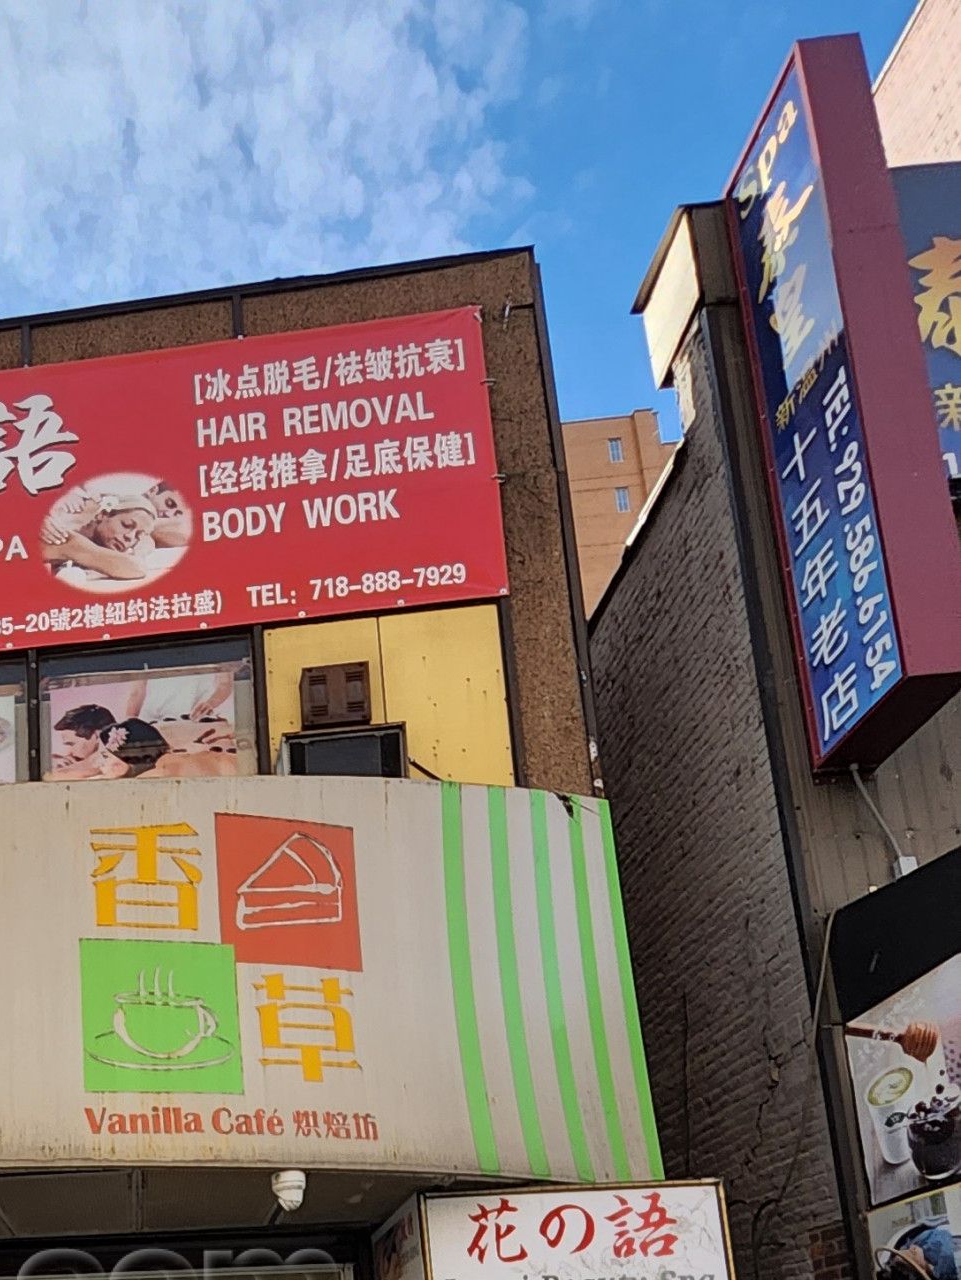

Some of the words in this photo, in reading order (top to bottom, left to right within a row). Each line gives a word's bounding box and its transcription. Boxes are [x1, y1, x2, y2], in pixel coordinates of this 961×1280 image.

[738, 100, 798, 221] Spa
[193, 338, 465, 406] [冰点脱毛/祛皱抗衰]
[197, 412, 267, 448] HAIR
[283, 391, 435, 437] REMOVAL
[199, 431, 476, 498] [经络推拿/足底保健]
[202, 502, 286, 542] BODY
[302, 489, 400, 529] WORK
[246, 584, 298, 608] TEL:
[309, 562, 467, 600] 718-888-7929
[782, 427, 861, 742] 十五年老店
[89, 822, 204, 932] 香
[252, 972, 364, 1083] 草
[84, 1105, 204, 1135] Vanilla
[211, 1106, 285, 1137] Café
[467, 1191, 679, 1265] 花の語
